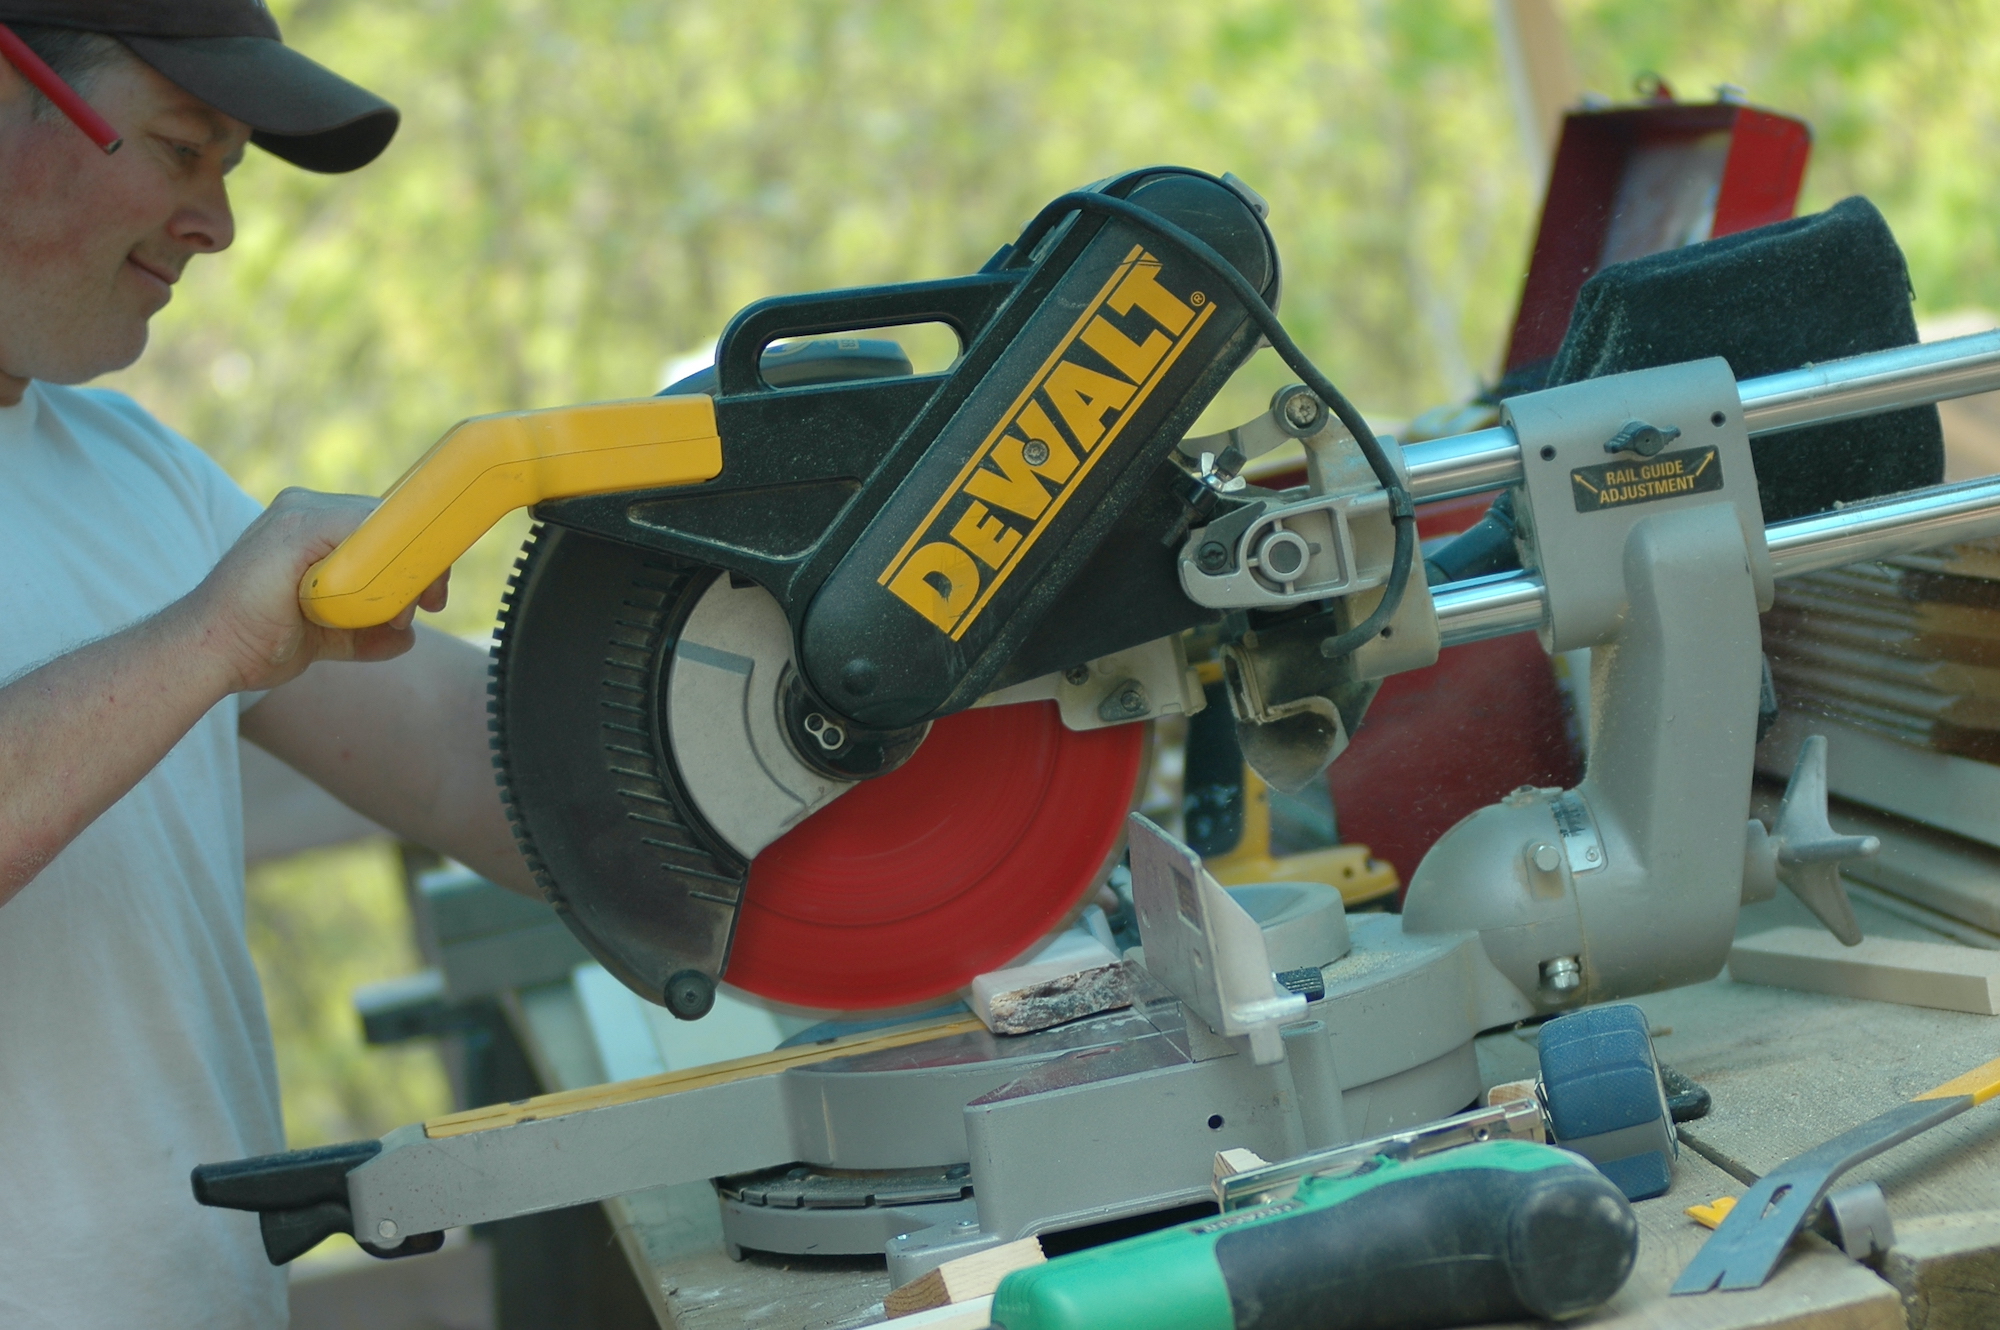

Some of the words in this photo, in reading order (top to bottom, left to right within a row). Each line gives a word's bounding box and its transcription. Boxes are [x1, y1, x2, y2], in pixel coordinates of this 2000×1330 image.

[888, 251, 1196, 634] DEWALT
[1606, 470, 1639, 486] RAIL
[1641, 460, 1684, 480] GUIDE
[1600, 475, 1696, 504] ADJUSTMENT
